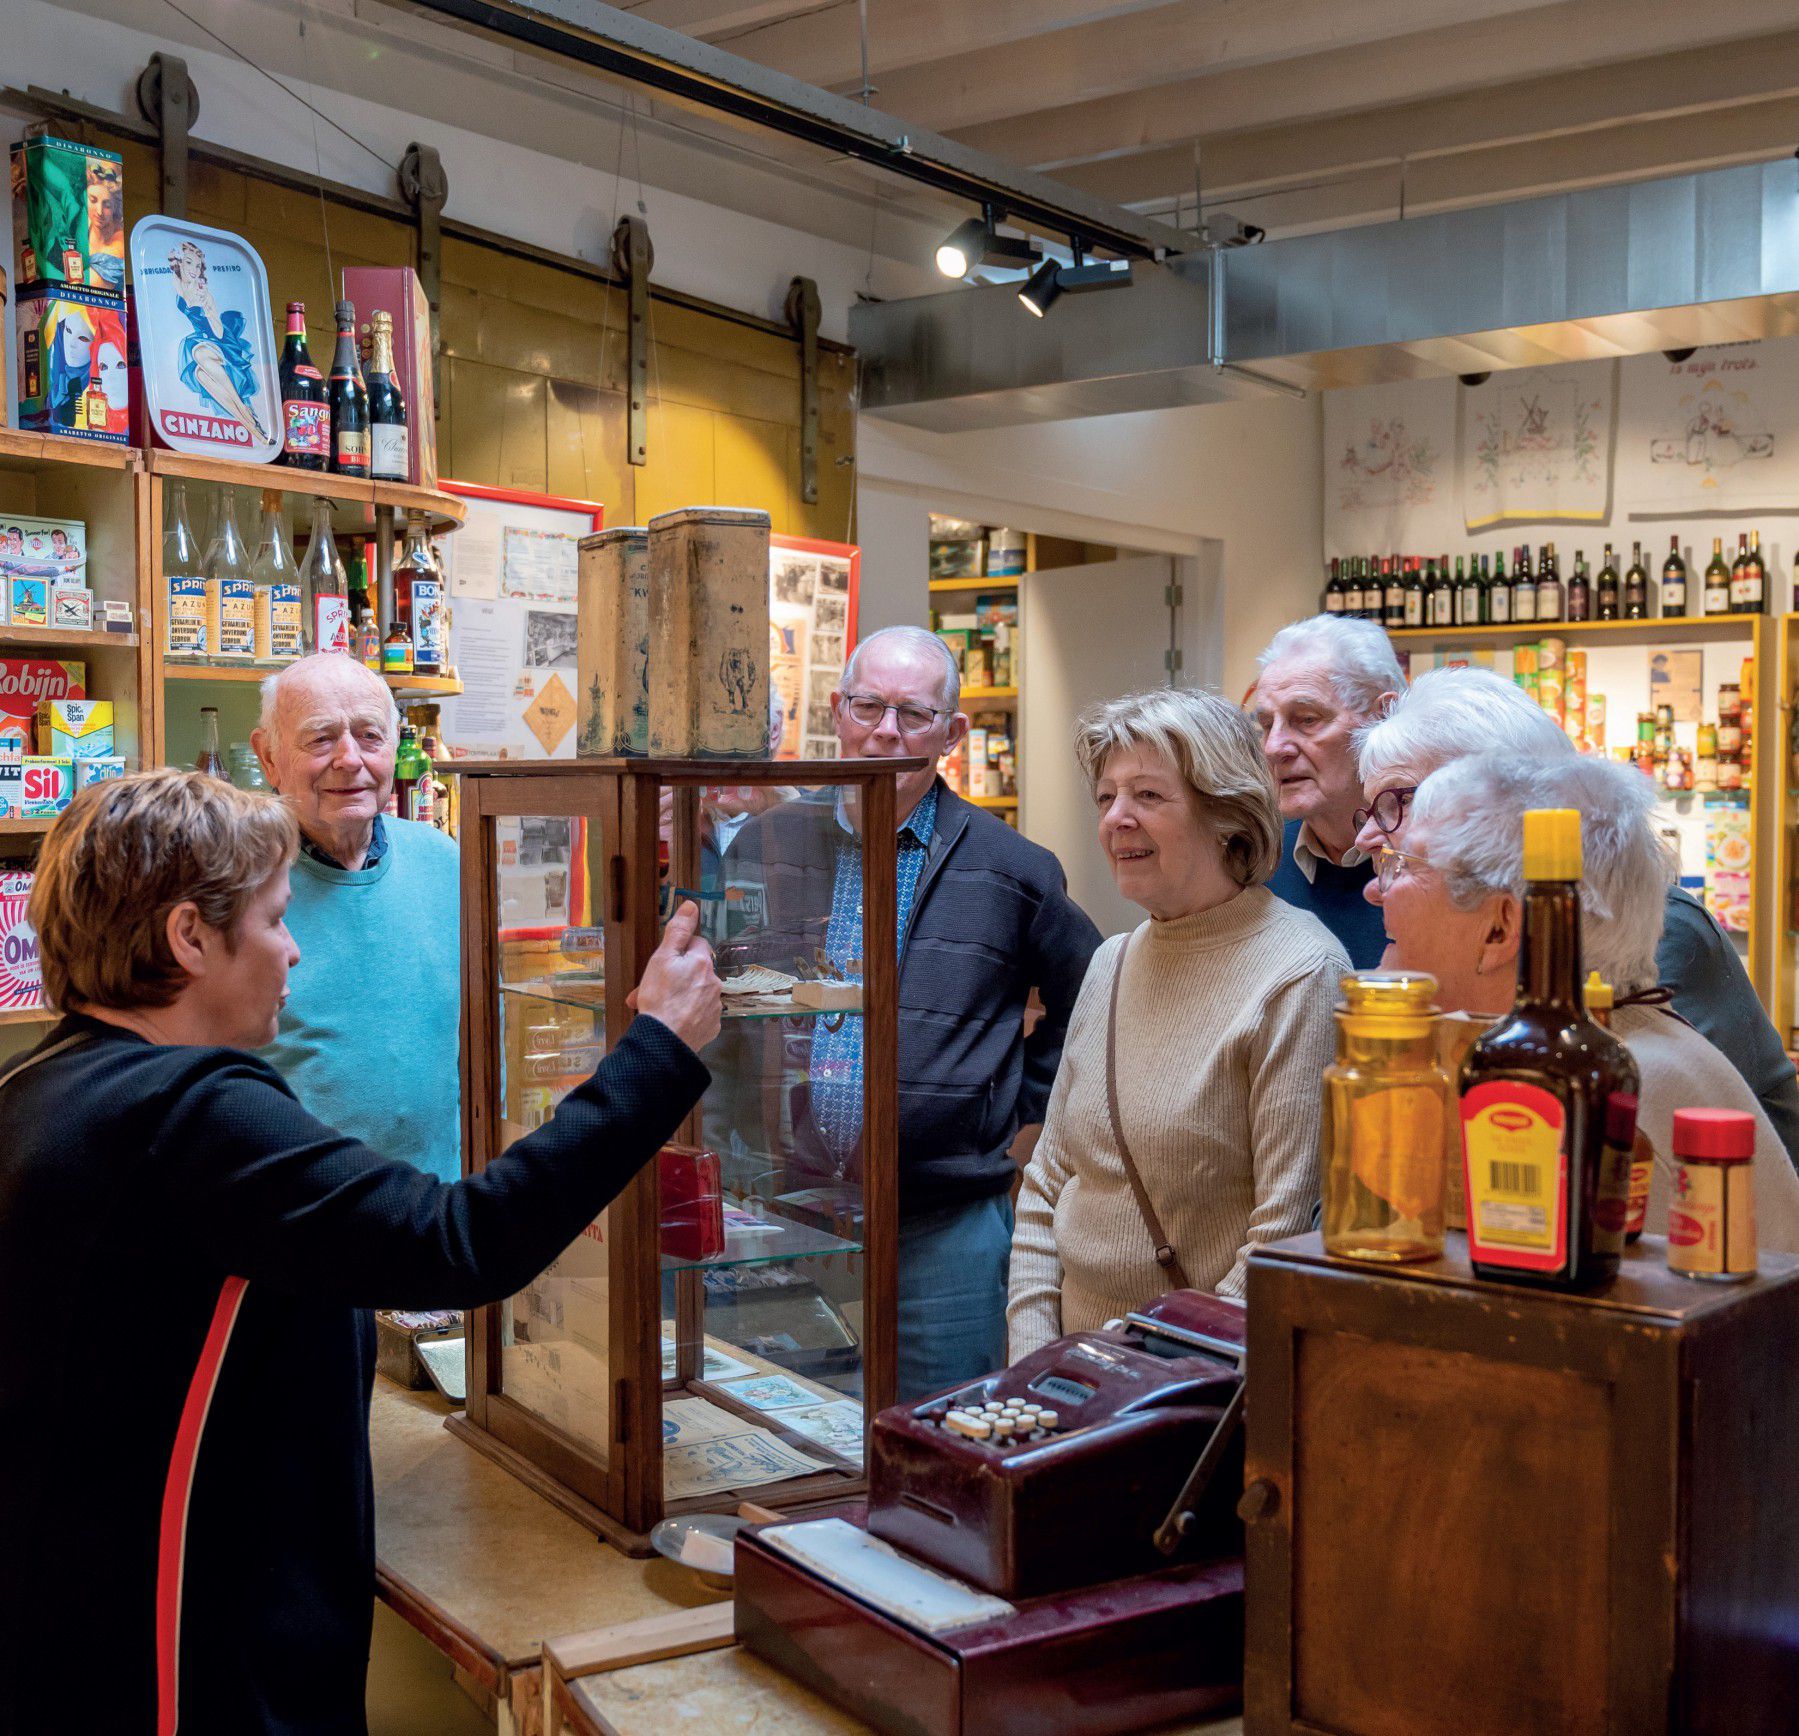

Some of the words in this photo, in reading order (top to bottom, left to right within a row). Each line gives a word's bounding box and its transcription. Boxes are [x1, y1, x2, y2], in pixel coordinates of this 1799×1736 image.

[56, 141, 112, 159] DISARONNO
[212, 265, 241, 273] PREFIRO
[60, 283, 90, 293] AMARETTO
[90, 289, 120, 299] ORIGINALE
[60, 292, 117, 307] DISARONNO
[60, 429, 92, 438] AMARETTO
[94, 433, 127, 442] ORIGINALE
[165, 414, 249, 443] CINZANO
[67, 703, 81, 714] Spic
[67, 713, 85, 722] Span
[25, 768, 59, 799] Sil
[15, 880, 32, 892] OM
[4, 935, 40, 965] OM
